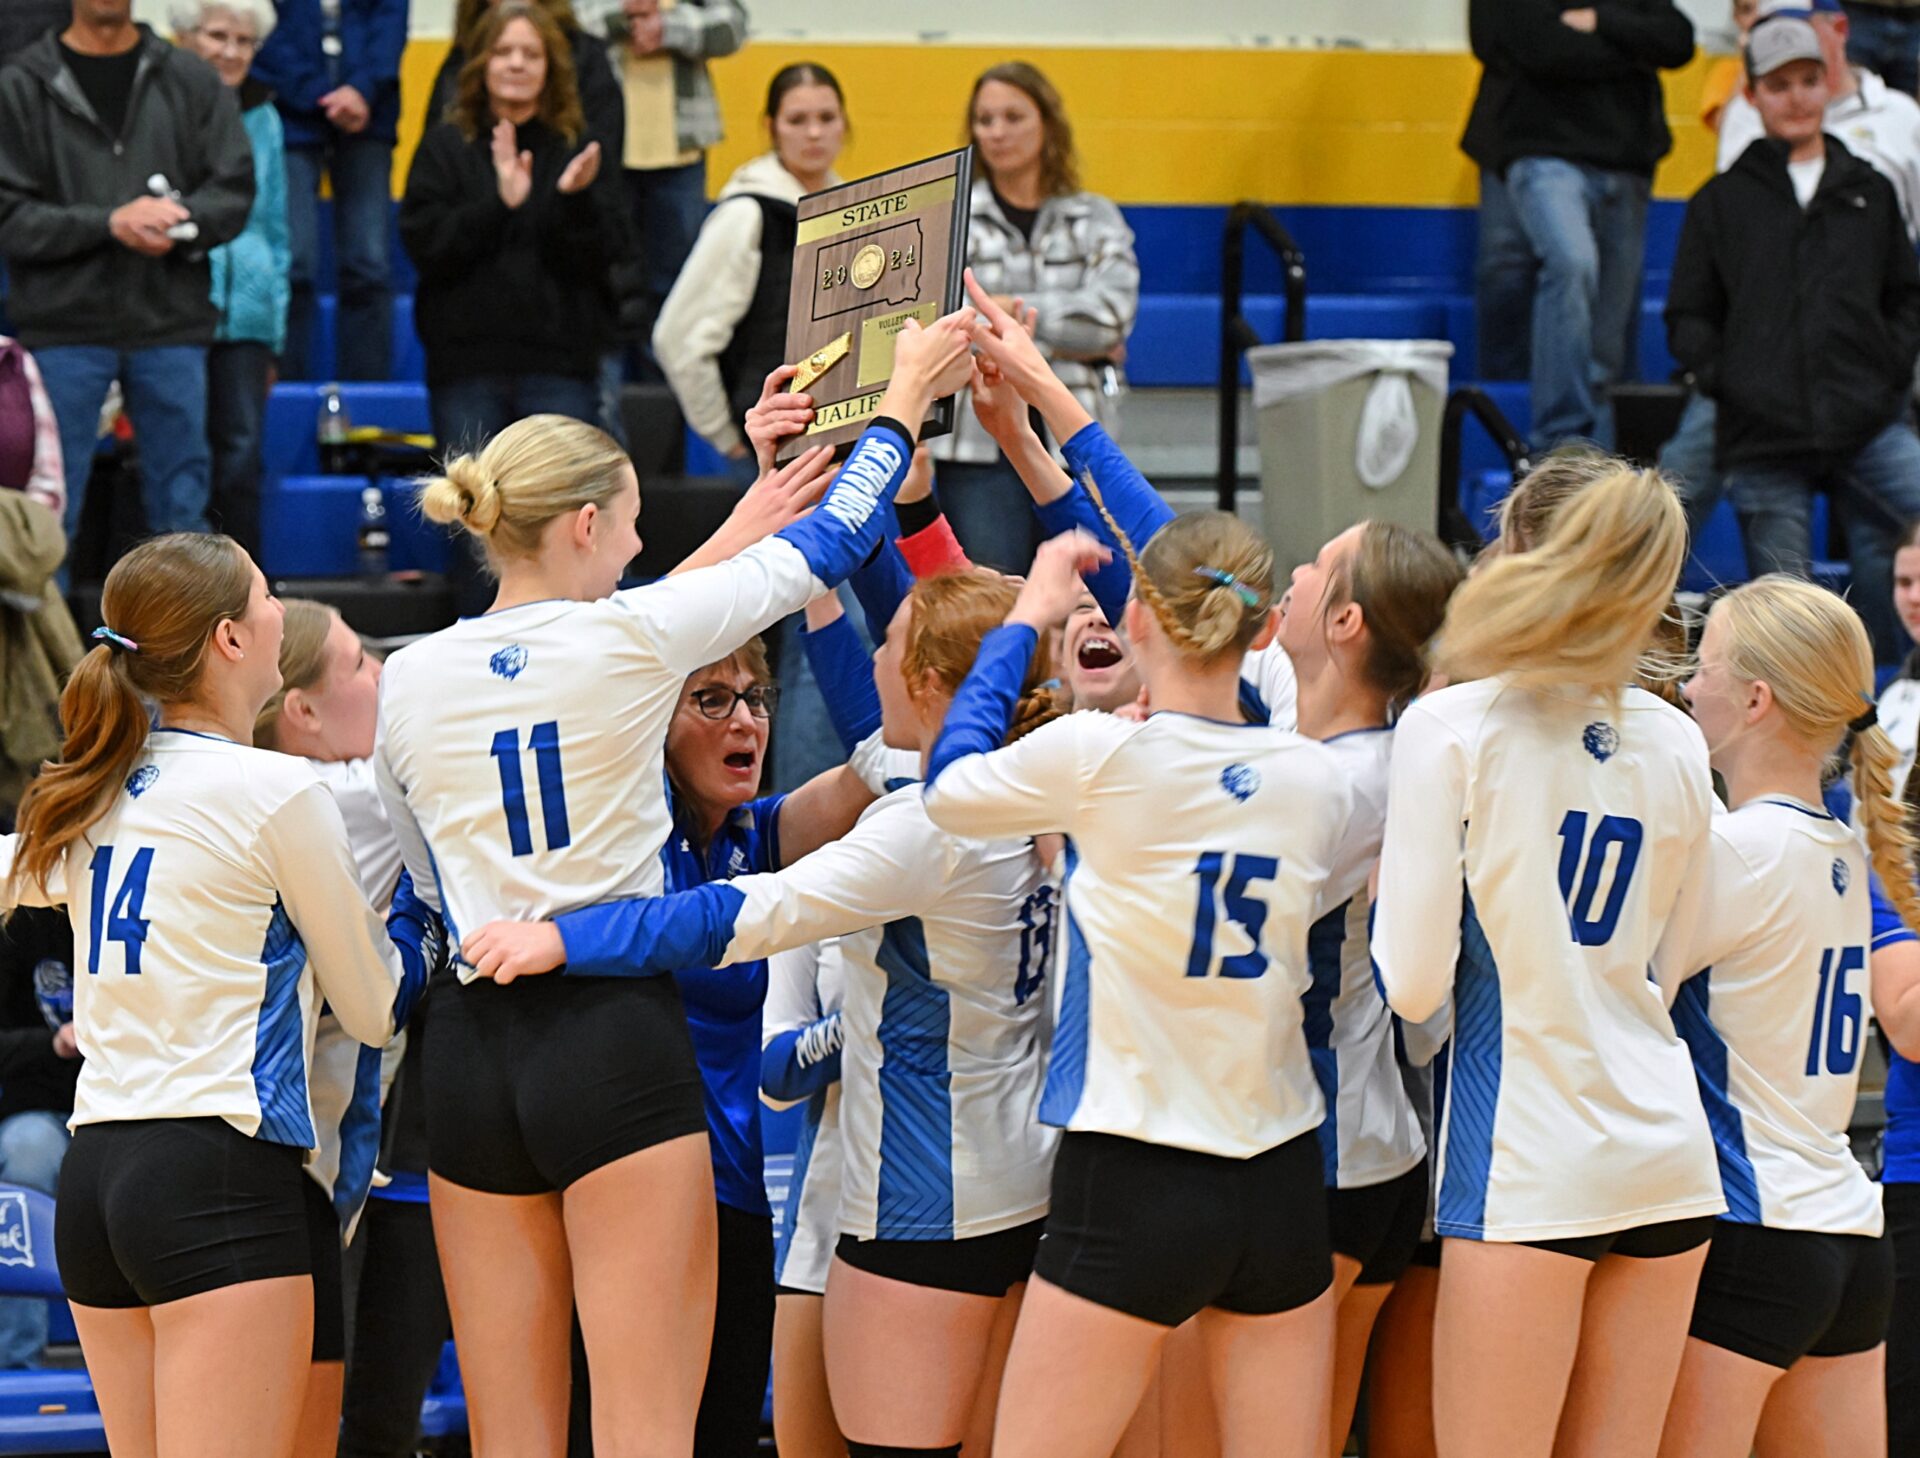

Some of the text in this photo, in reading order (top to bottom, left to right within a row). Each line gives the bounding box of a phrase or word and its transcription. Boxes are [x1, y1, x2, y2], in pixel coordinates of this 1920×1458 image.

[842, 194, 908, 227] STATE
[823, 264, 848, 290] 20
[891, 245, 915, 271] 24
[814, 393, 885, 427] UALIF
[823, 437, 902, 535] MONARCHS
[491, 721, 571, 857] 11
[88, 845, 155, 975] 14
[1184, 850, 1279, 979] 15
[1557, 810, 1644, 947] 10
[795, 1012, 844, 1069] MONA
[1805, 945, 1866, 1077] 16
